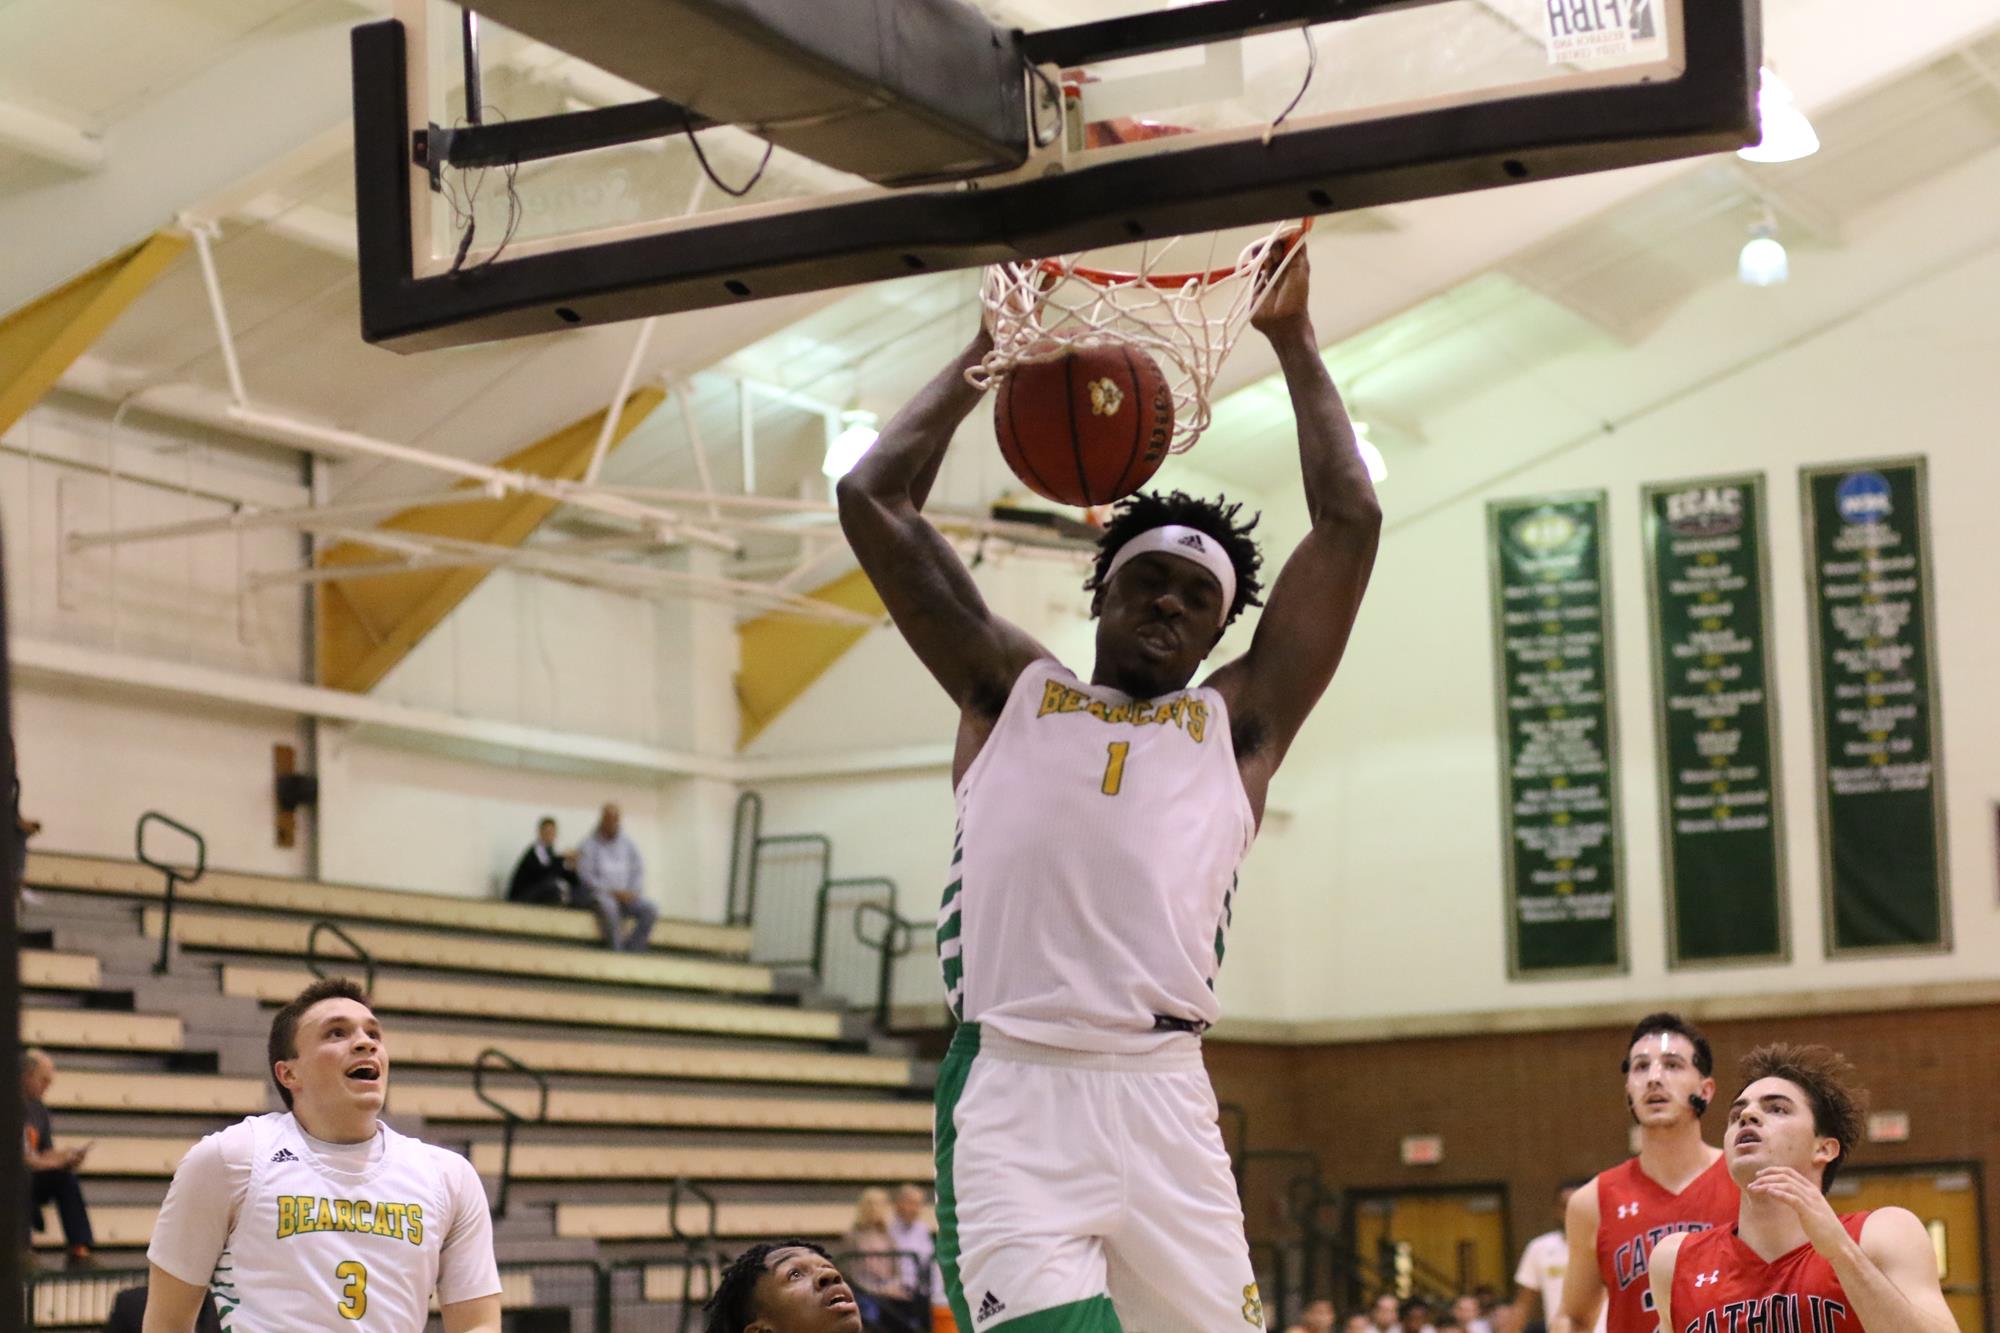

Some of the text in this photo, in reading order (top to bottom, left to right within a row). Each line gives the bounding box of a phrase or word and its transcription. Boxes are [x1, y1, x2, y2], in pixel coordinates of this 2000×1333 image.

[1036, 678, 1209, 744] BEARCATS
[1101, 740, 1130, 796] 1
[276, 1195, 424, 1247] BEARCATS
[335, 1260, 368, 1321] 3
